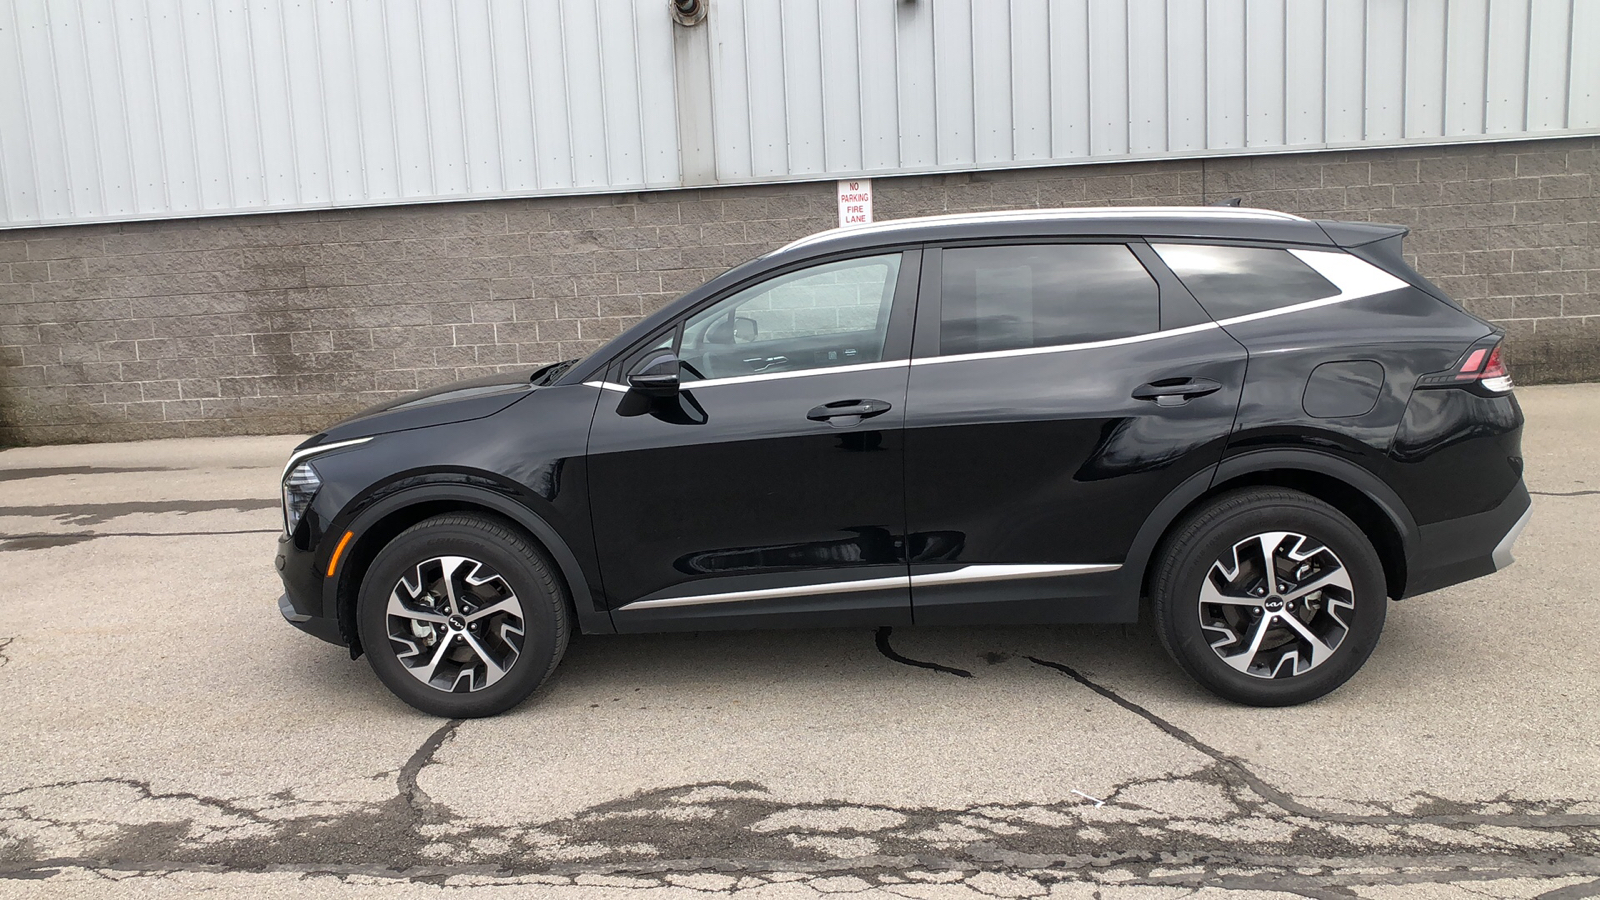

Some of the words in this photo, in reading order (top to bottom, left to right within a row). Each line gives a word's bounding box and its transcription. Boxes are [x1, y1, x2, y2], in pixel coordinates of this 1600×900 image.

[849, 182, 859, 191] NO
[841, 193, 869, 202] PARKING
[847, 205, 864, 213] FIRE
[845, 215, 866, 223] LANE
